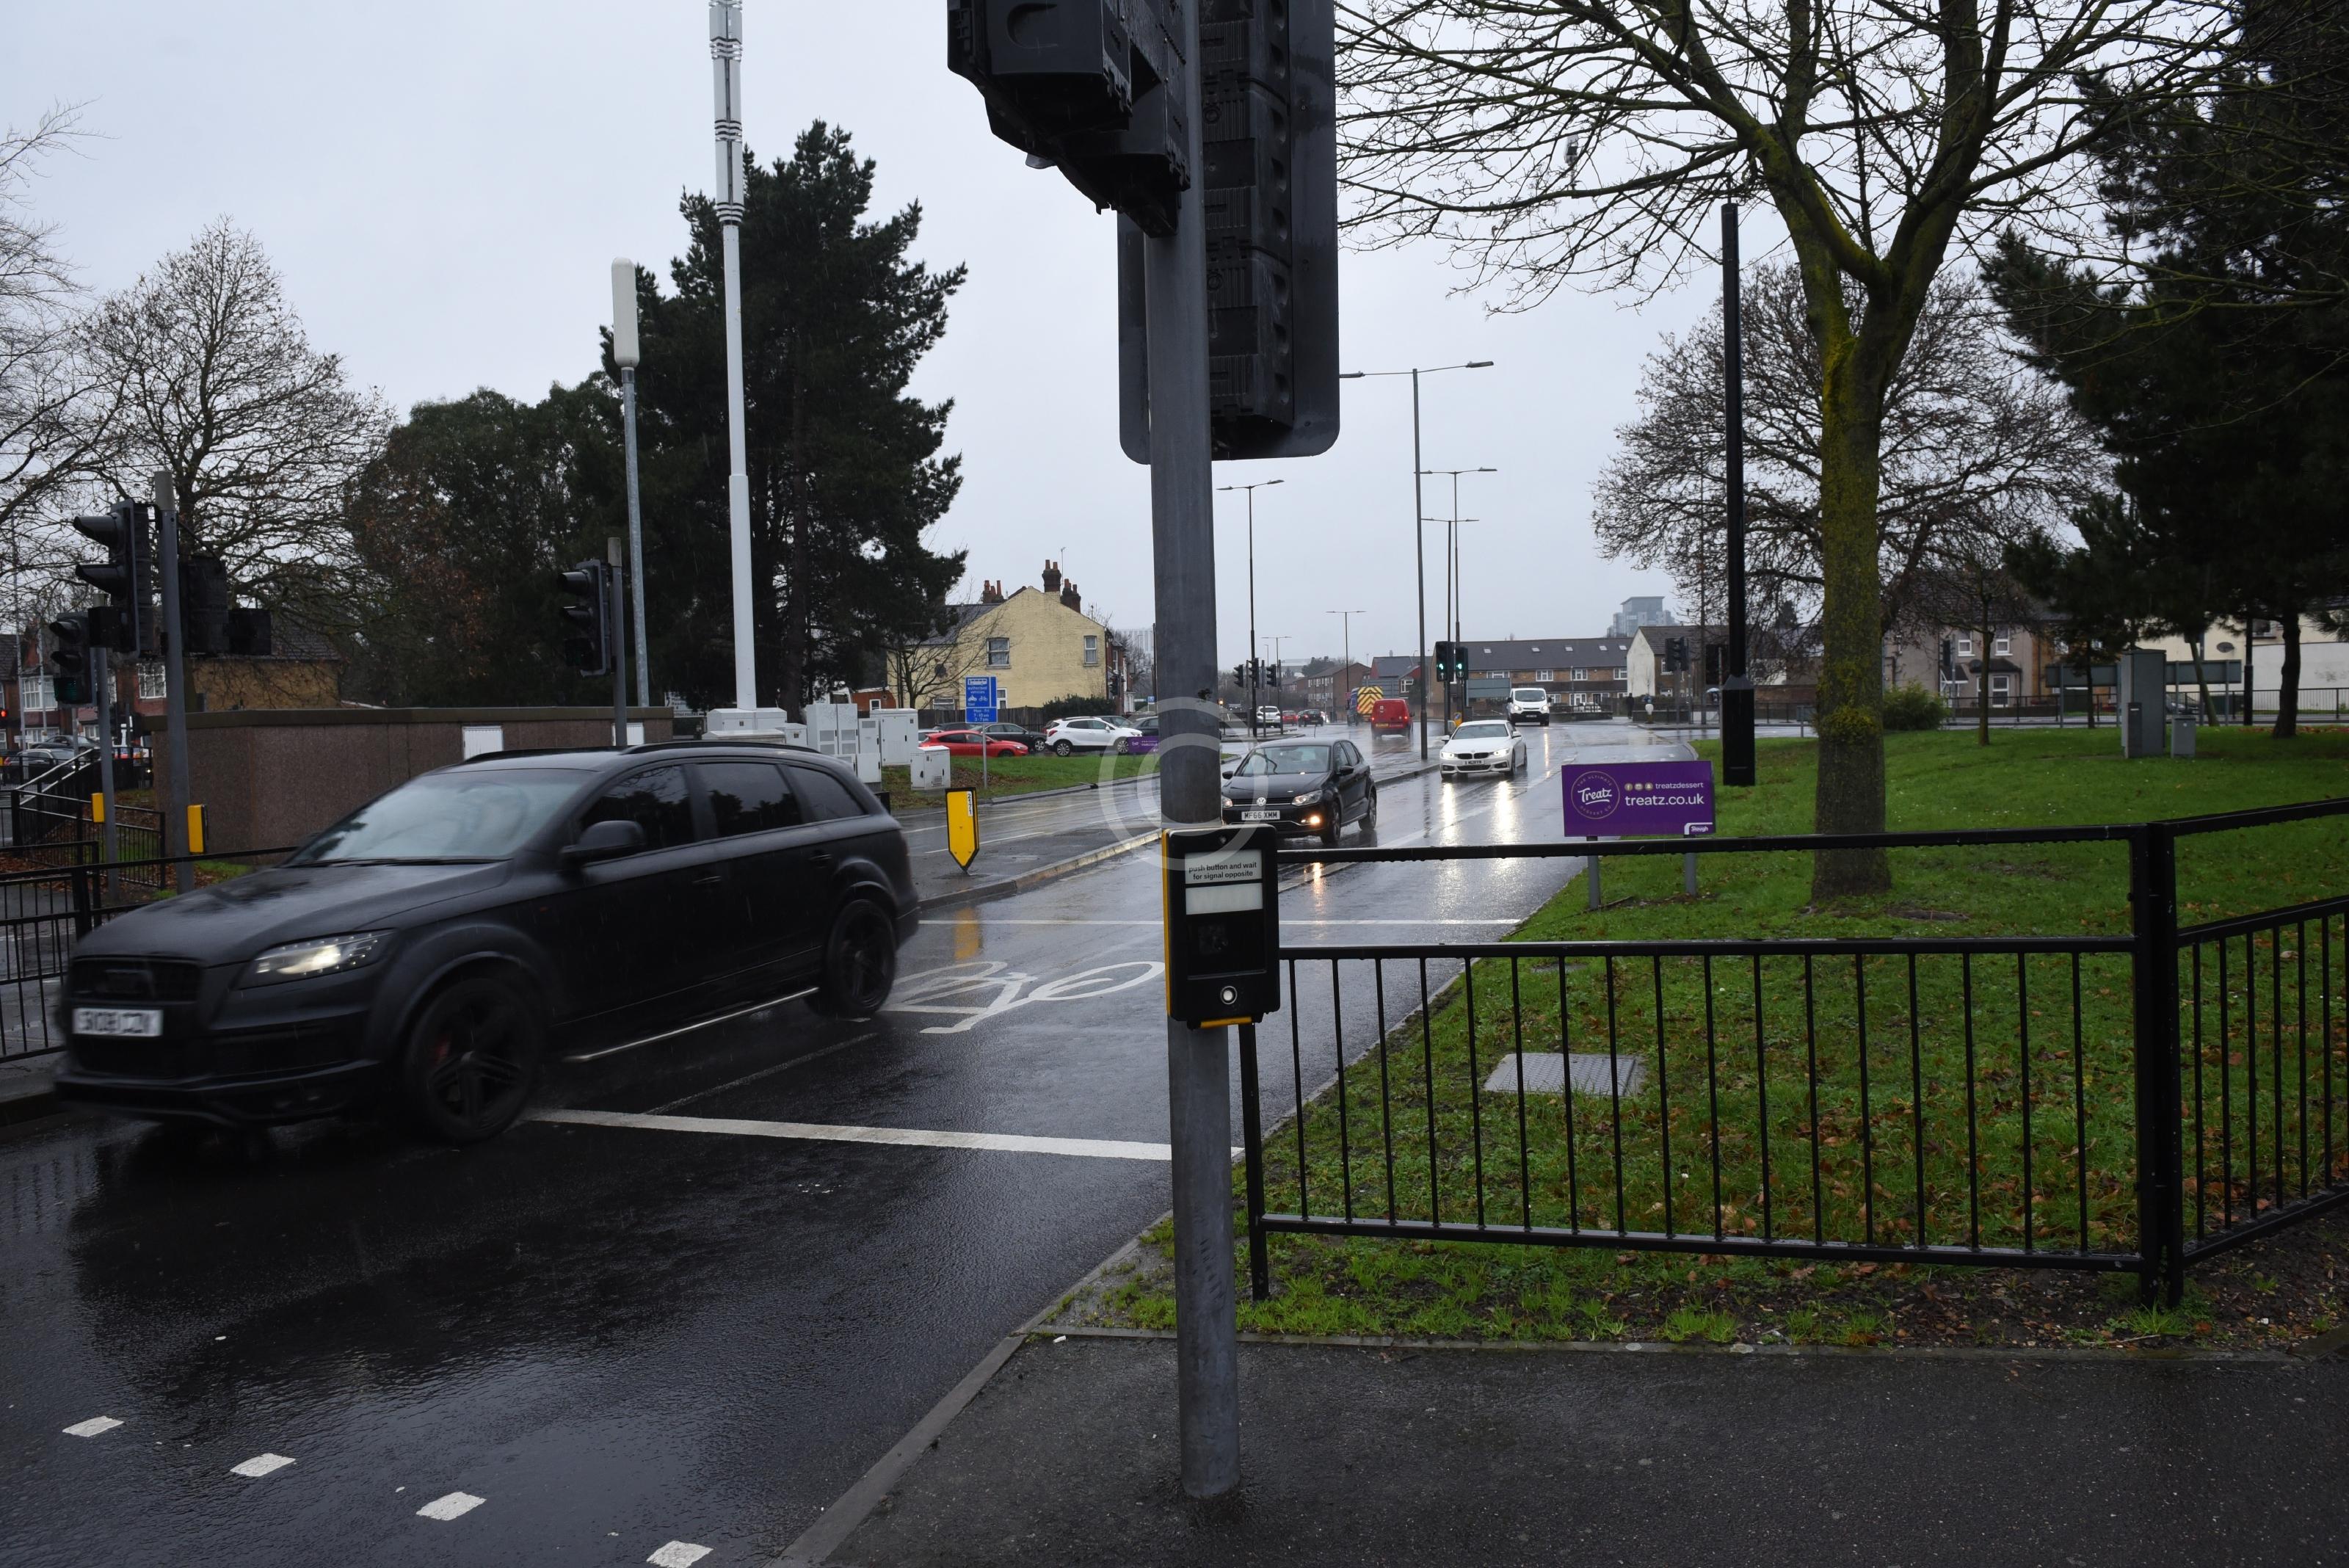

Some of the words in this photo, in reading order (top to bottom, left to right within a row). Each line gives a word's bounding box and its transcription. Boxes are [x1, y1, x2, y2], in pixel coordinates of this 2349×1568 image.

[1577, 787, 1613, 803] Treatz
[1624, 793, 1704, 806] treatz.co.uk
[1188, 865, 1205, 874] push
[1206, 863, 1228, 871] button
[1204, 871, 1224, 880] signal
[1224, 870, 1253, 879] opposite
